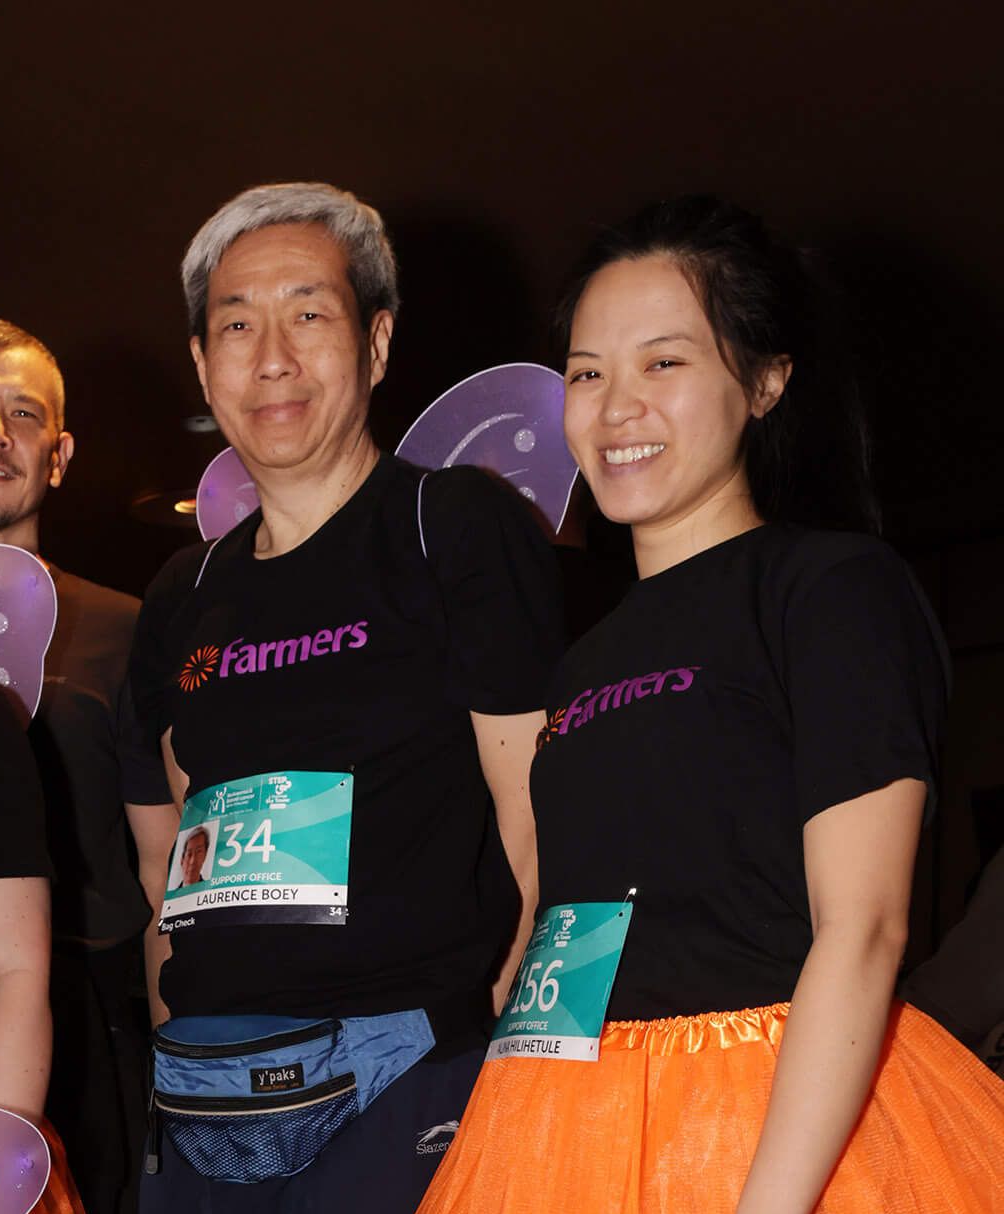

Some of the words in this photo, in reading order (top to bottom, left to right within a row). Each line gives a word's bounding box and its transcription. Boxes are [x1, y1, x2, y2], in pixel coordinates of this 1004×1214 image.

[219, 620, 369, 678] Farmers
[218, 819, 275, 867] 34
[210, 873, 246, 886] SUPPORT
[248, 872, 283, 882] OFFICE
[196, 889, 257, 906] LAURENCE
[261, 889, 299, 900] BOEY
[161, 922, 174, 932] Bag
[175, 917, 195, 928] Check
[510, 960, 564, 1014] 156
[258, 1068, 296, 1086] y'paks
[416, 1142, 450, 1155] Slazen
